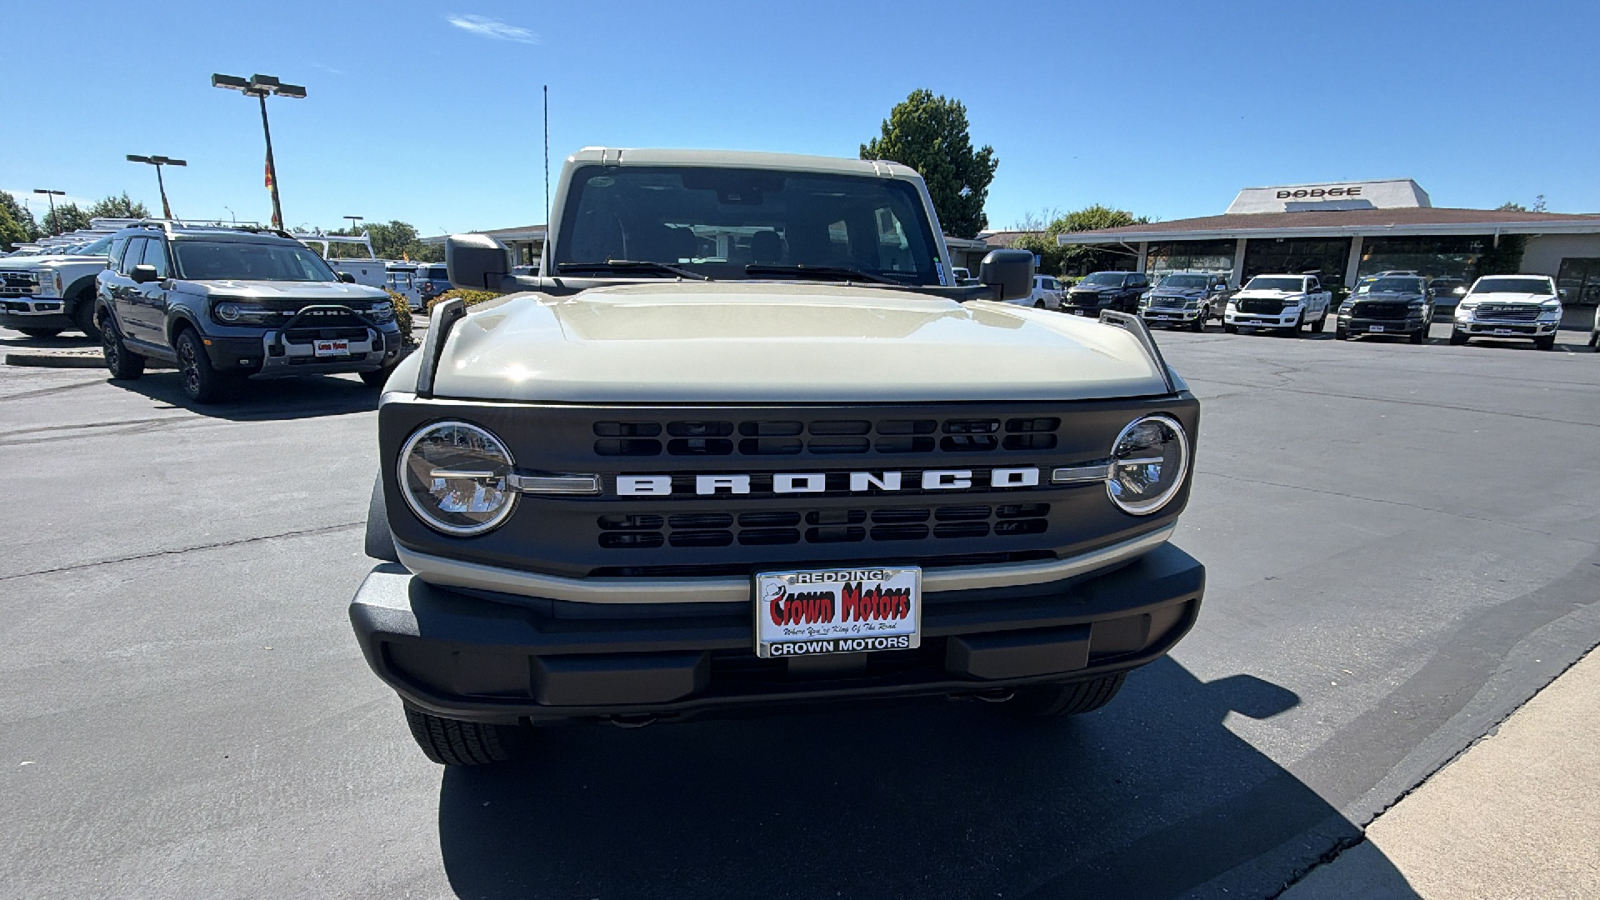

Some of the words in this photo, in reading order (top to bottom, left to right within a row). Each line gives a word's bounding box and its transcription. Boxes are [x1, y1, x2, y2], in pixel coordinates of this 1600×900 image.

[1276, 187, 1362, 199] DODGE
[616, 467, 1039, 496] BRONCO
[798, 571, 883, 583] REDDING
[769, 585, 835, 627] Crown
[841, 582, 911, 623] Motors
[783, 627, 806, 636] Where
[832, 625, 849, 634] King
[851, 624, 861, 633] Of
[863, 623, 876, 631] The
[878, 622, 897, 630] Road
[771, 641, 834, 656] CROWN
[839, 637, 909, 651] MOTORS
